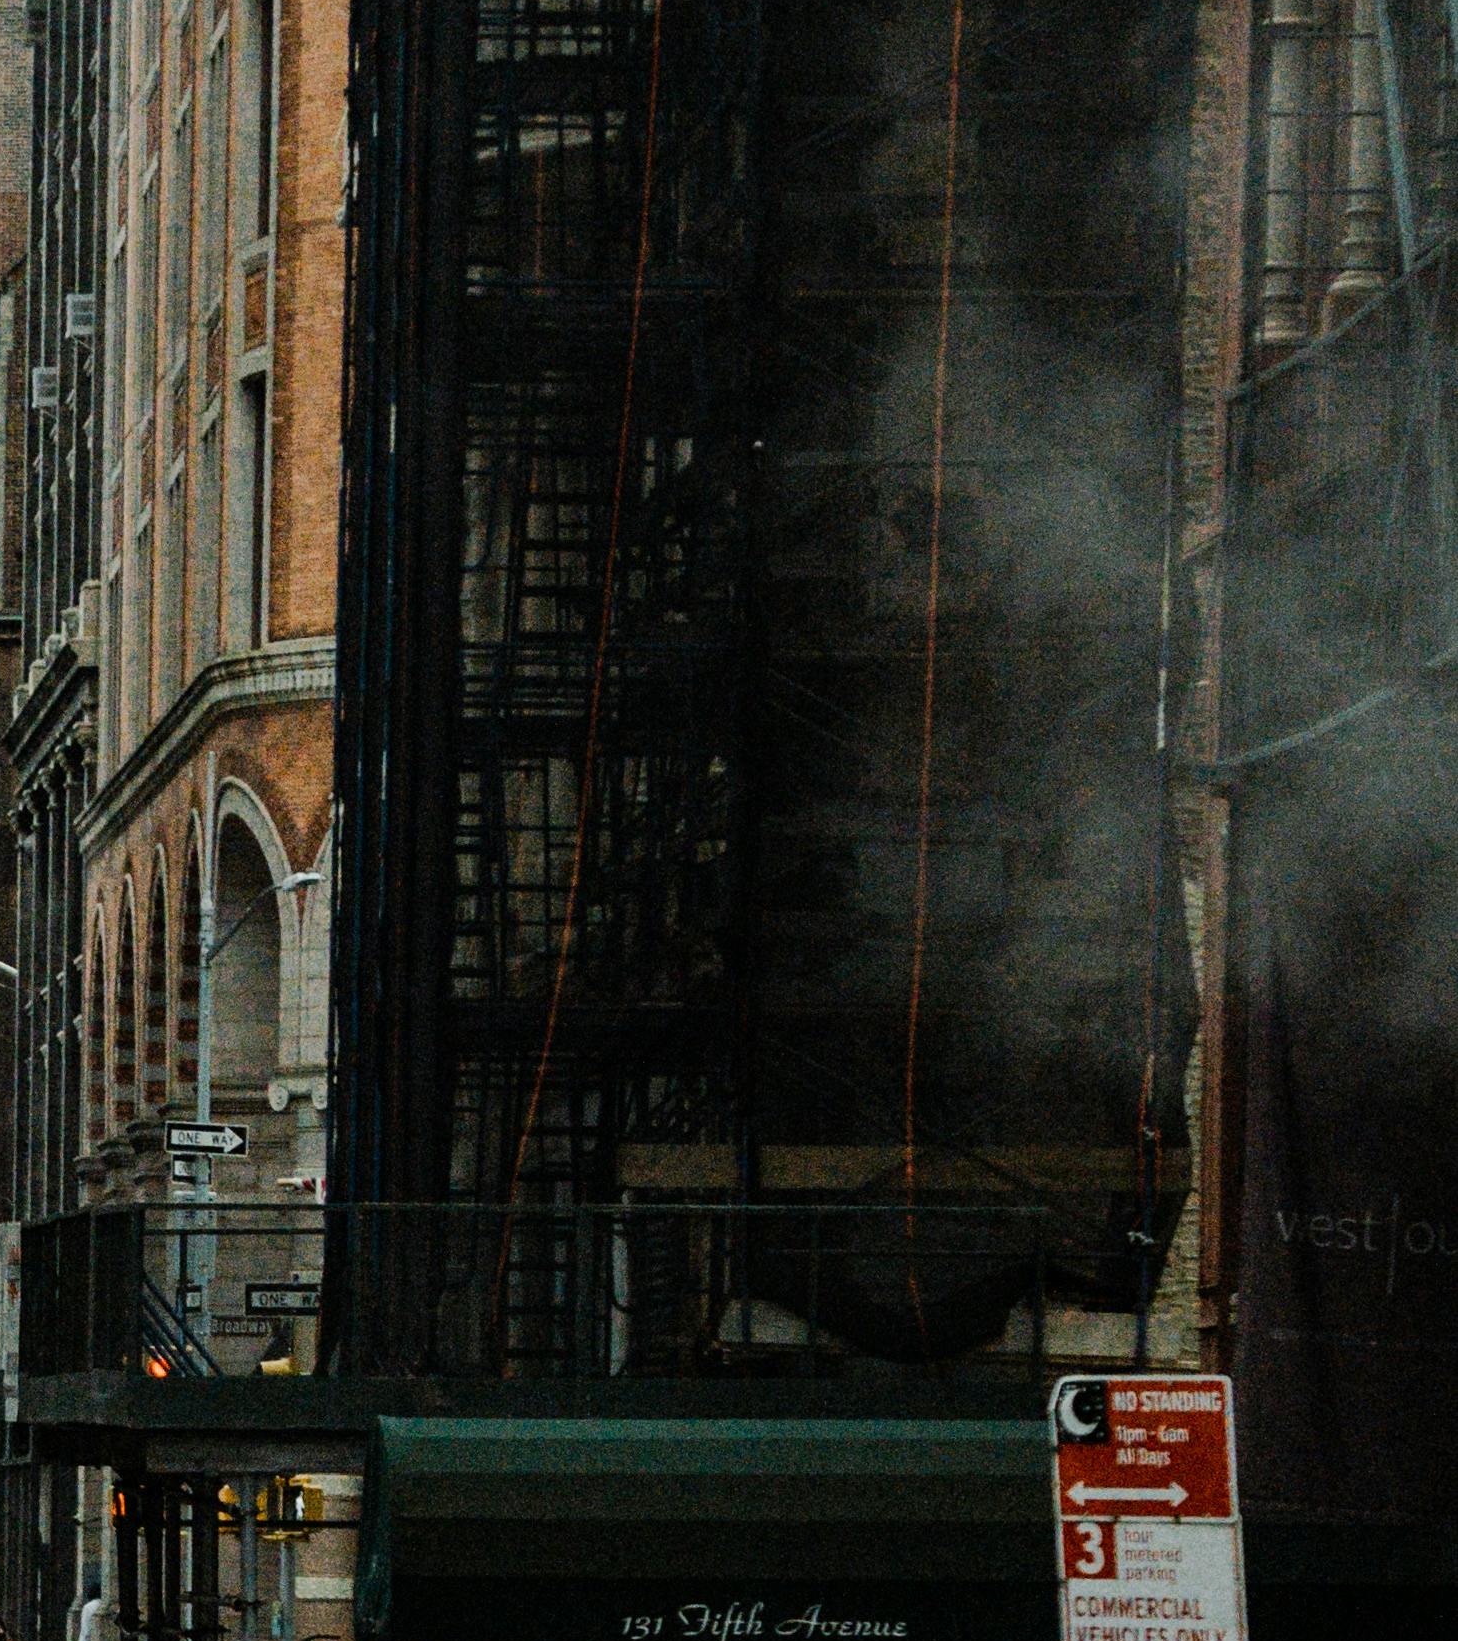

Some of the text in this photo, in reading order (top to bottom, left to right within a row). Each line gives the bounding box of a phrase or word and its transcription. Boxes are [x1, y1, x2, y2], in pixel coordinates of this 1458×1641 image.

[178, 1132, 233, 1146] ONE WAY
[259, 1294, 322, 1307] ONE WA
[211, 1317, 273, 1334] Broadway
[1113, 1391, 1223, 1412] NO STANDING
[1158, 1425, 1190, 1443] 6am
[1117, 1447, 1171, 1468] All Days
[1076, 1522, 1105, 1575] 3
[1074, 1595, 1205, 1620] COMMERCIAL
[621, 1616, 663, 1640] 131
[775, 1604, 908, 1639] Avenue
